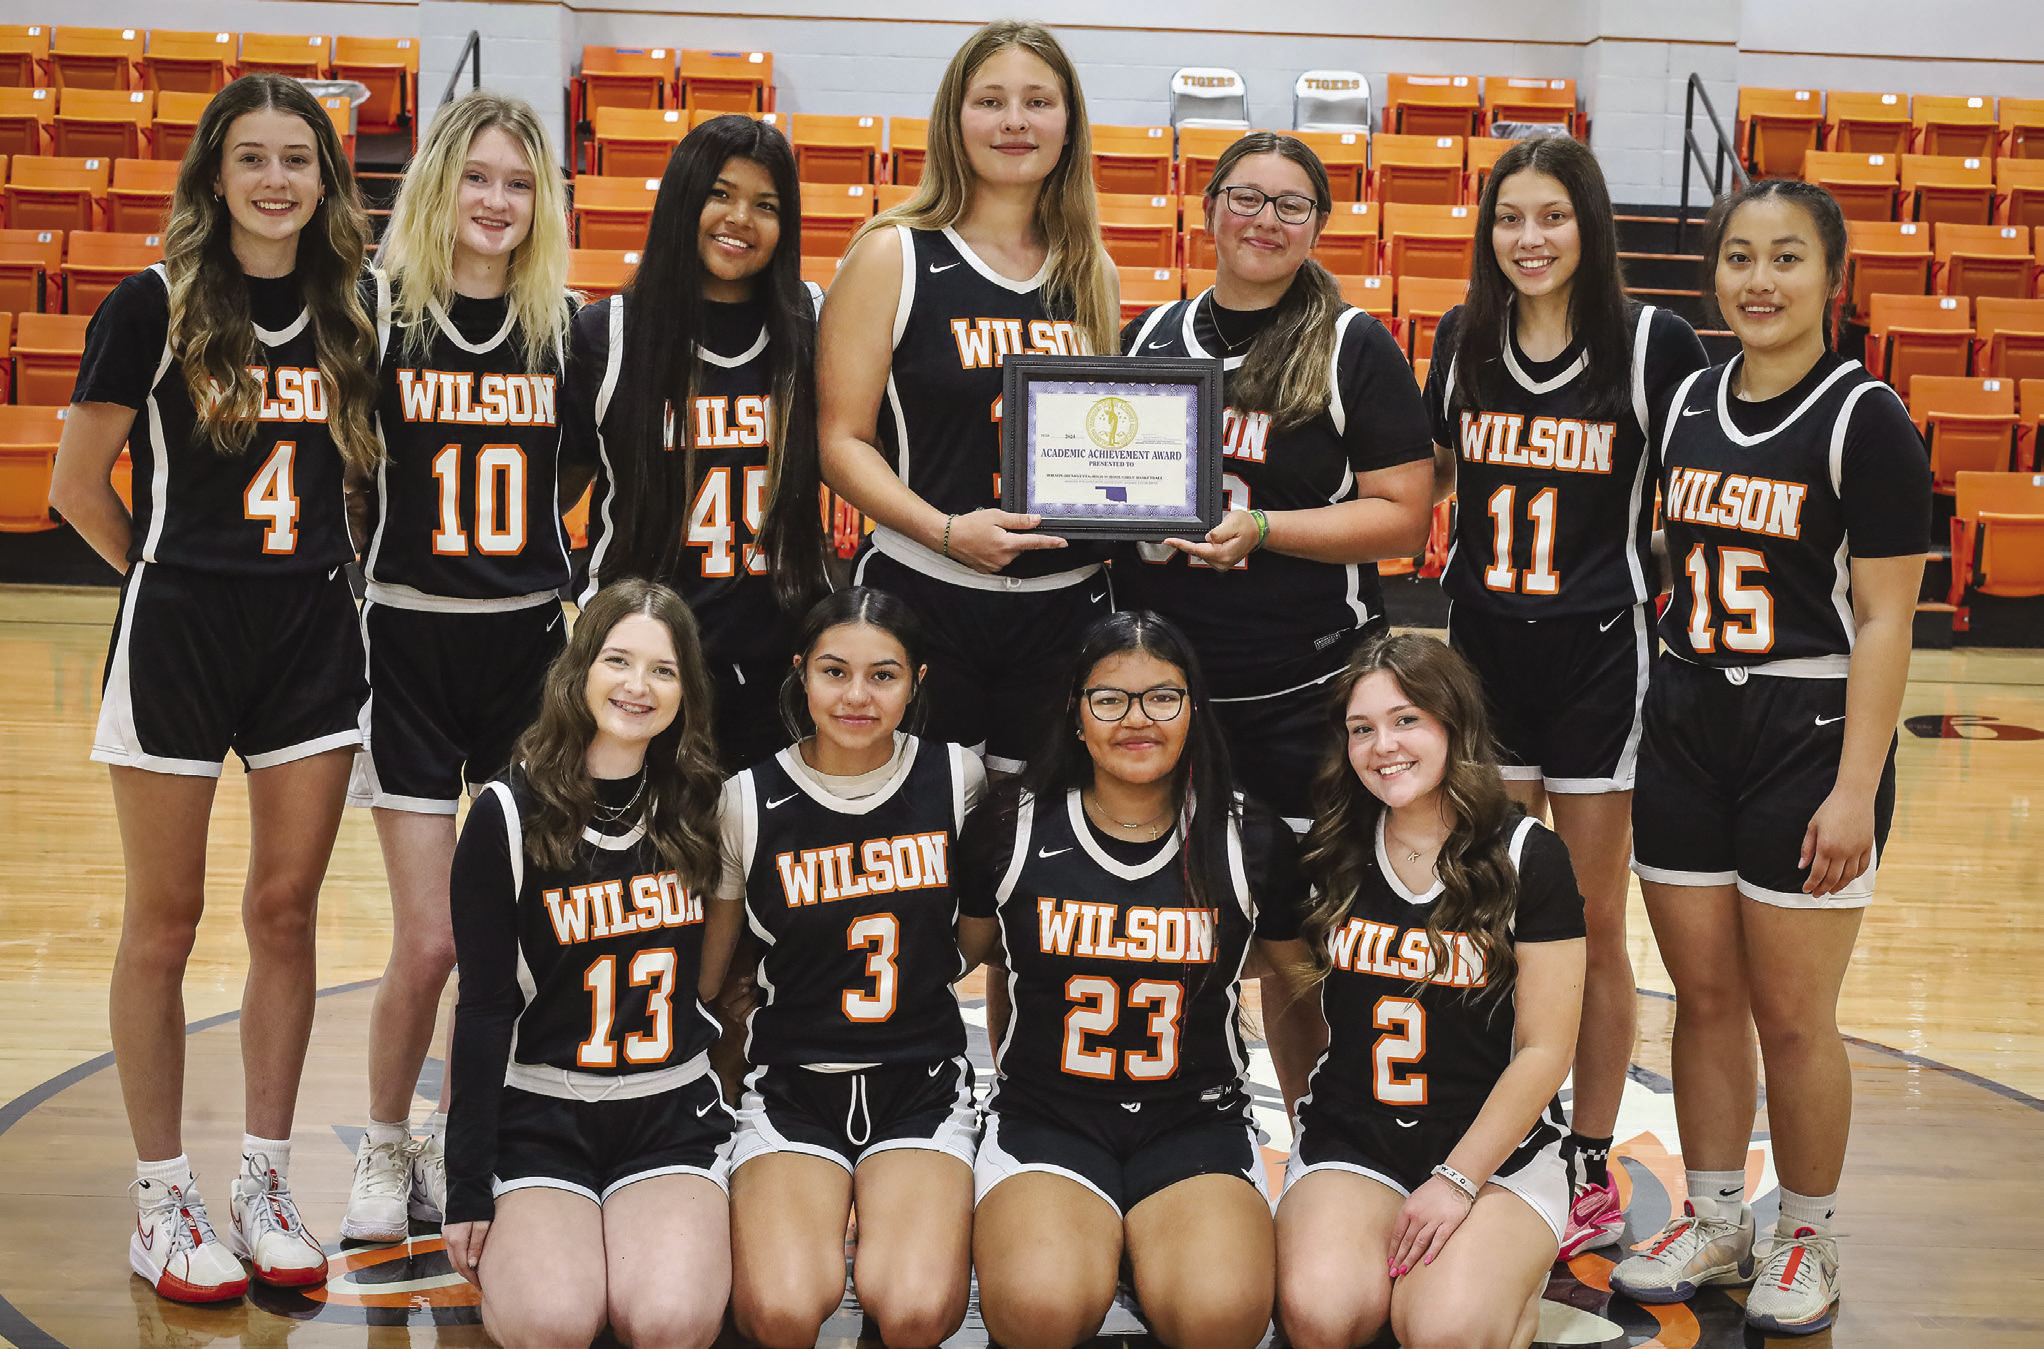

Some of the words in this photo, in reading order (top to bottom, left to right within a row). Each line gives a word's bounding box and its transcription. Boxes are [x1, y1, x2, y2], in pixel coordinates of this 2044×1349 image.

[1181, 75, 1235, 88] TIGERS
[1305, 78, 1360, 91] TIGERS
[950, 317, 1095, 369] WILSO
[196, 366, 329, 423] LSO
[397, 368, 557, 427] WILSON
[1041, 448, 1086, 459] ACADEMIC
[1088, 449, 1150, 460] ACHIEVEMENT
[1152, 450, 1182, 461] AWARD
[1089, 460, 1125, 468] PRESENTED
[1460, 409, 1617, 474] WILSON
[243, 441, 300, 554] 4
[432, 444, 527, 556] 10
[1664, 466, 1808, 540] WILSON
[1484, 484, 1560, 595] 11
[1685, 543, 1775, 653] 15
[776, 831, 949, 908] WILSON
[1037, 897, 1219, 963] WILSON
[841, 912, 900, 1023] 3
[577, 947, 678, 1068] 13
[1061, 974, 1185, 1080] 23
[1372, 995, 1428, 1106] 2
